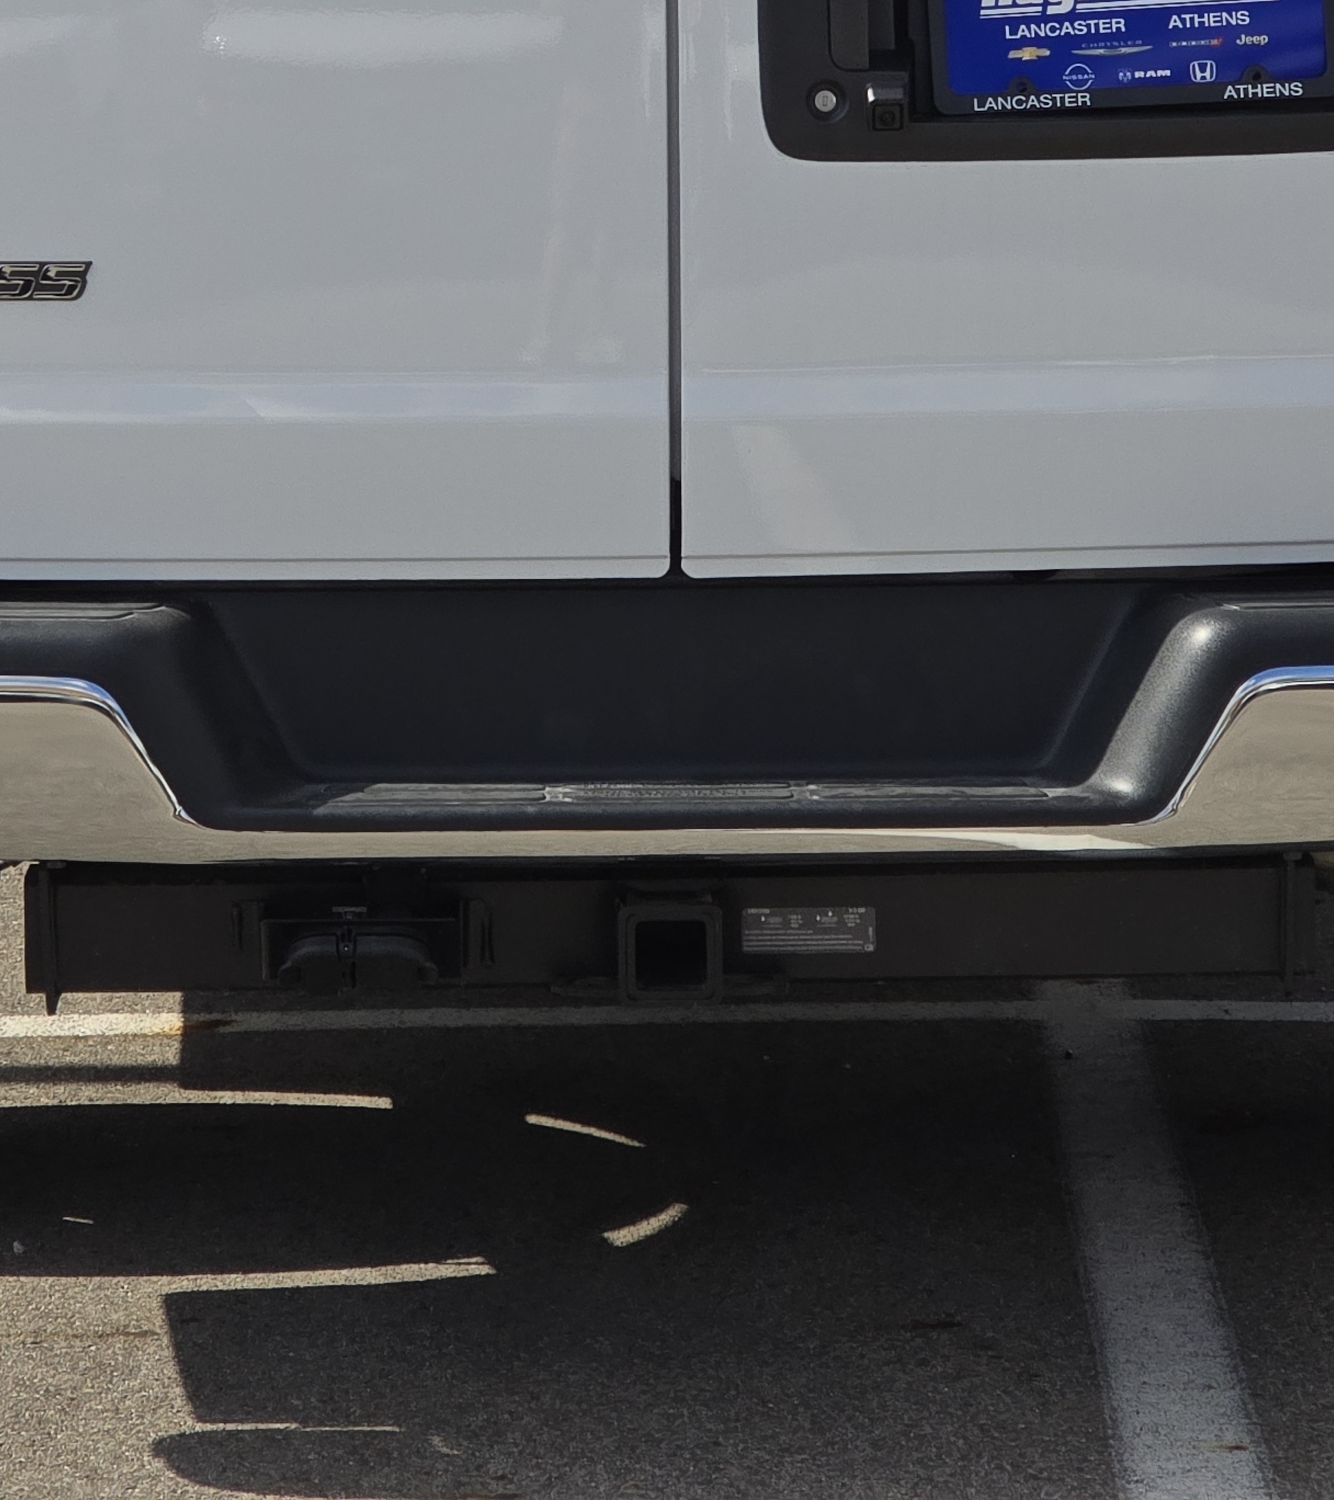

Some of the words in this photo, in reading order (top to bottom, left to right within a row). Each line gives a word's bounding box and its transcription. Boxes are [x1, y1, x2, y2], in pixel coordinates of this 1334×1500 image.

[1005, 18, 1126, 40] LANCASTER
[1168, 10, 1250, 30] ATHENS
[1236, 34, 1269, 46] Jeep
[1134, 69, 1171, 79] RAM
[973, 92, 1091, 112] LANCASTER
[1223, 82, 1304, 100] ATHENS
